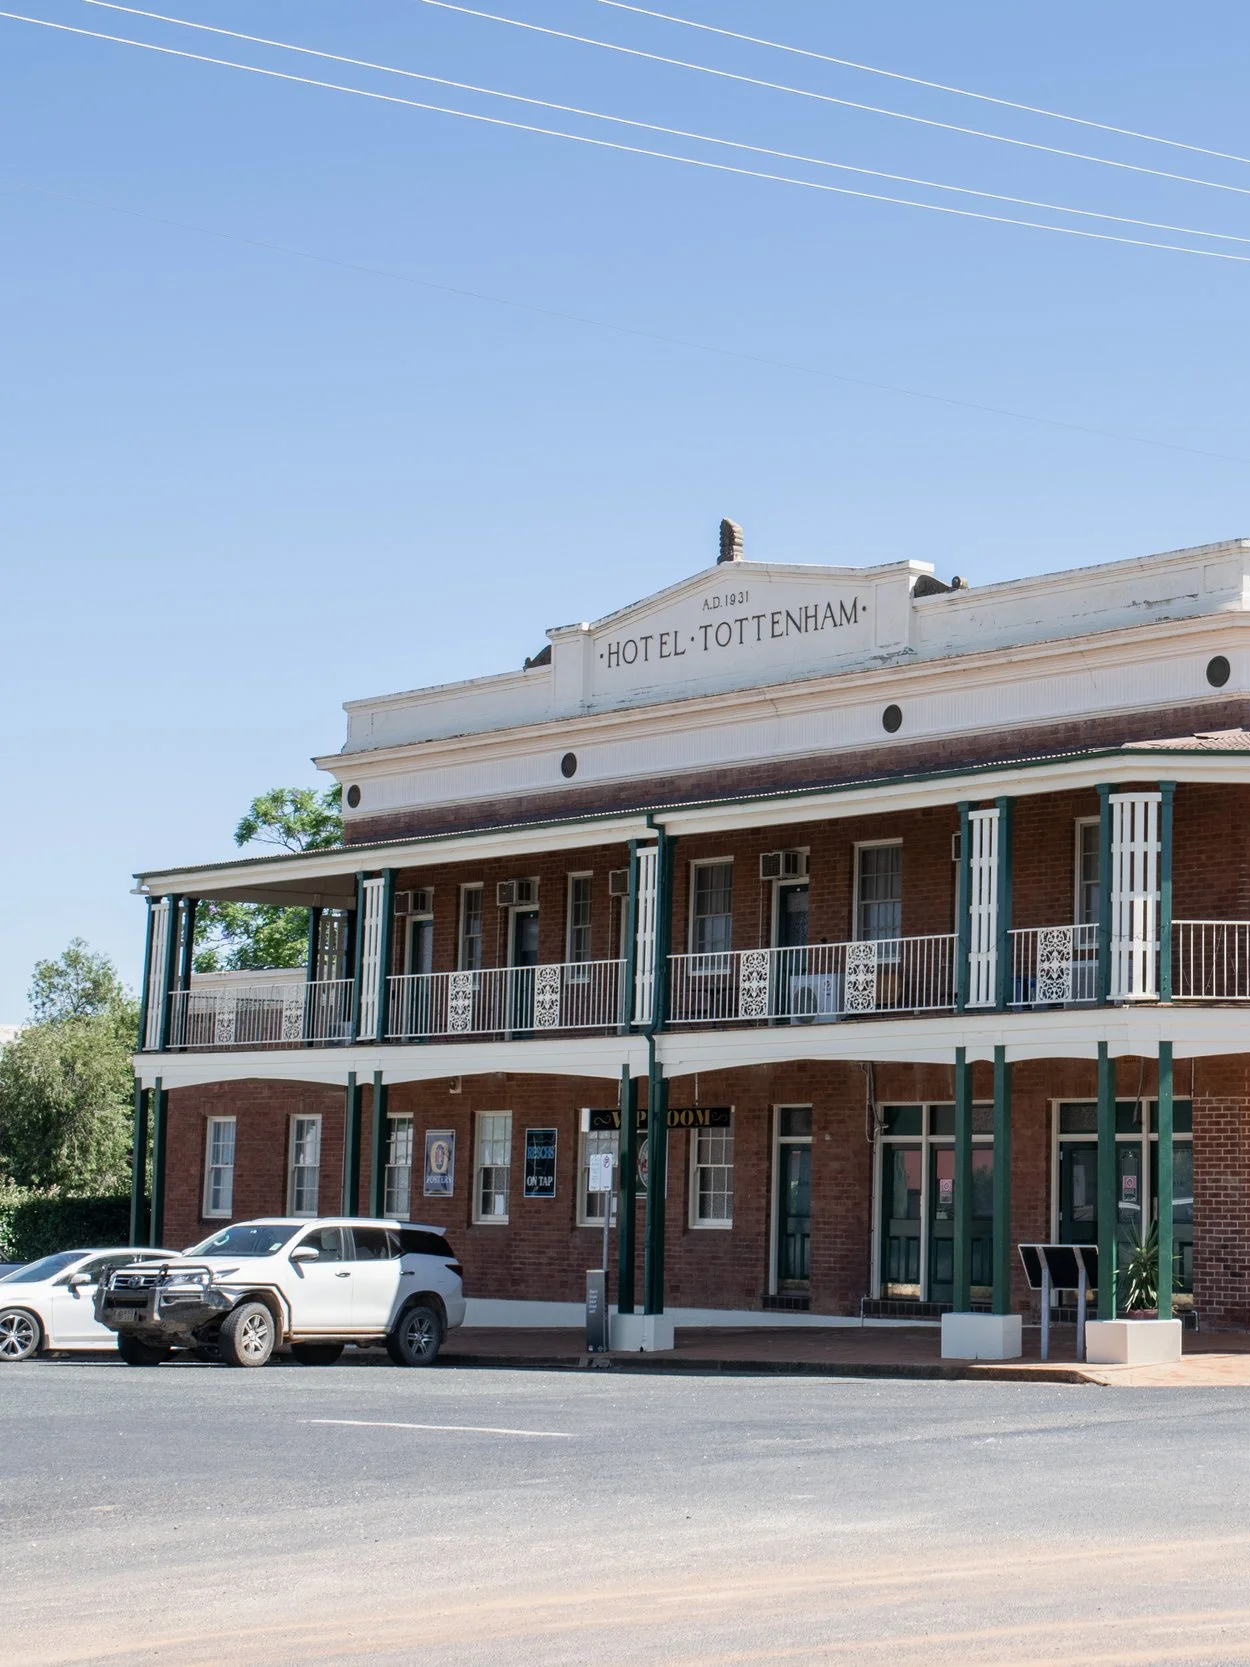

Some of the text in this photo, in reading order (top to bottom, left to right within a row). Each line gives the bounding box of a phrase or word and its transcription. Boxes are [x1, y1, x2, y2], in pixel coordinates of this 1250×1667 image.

[607, 597, 859, 669] HOTEL TOTTENHAM
[611, 1109, 711, 1128] VP OOM
[526, 1175, 553, 1187] ON TAP
